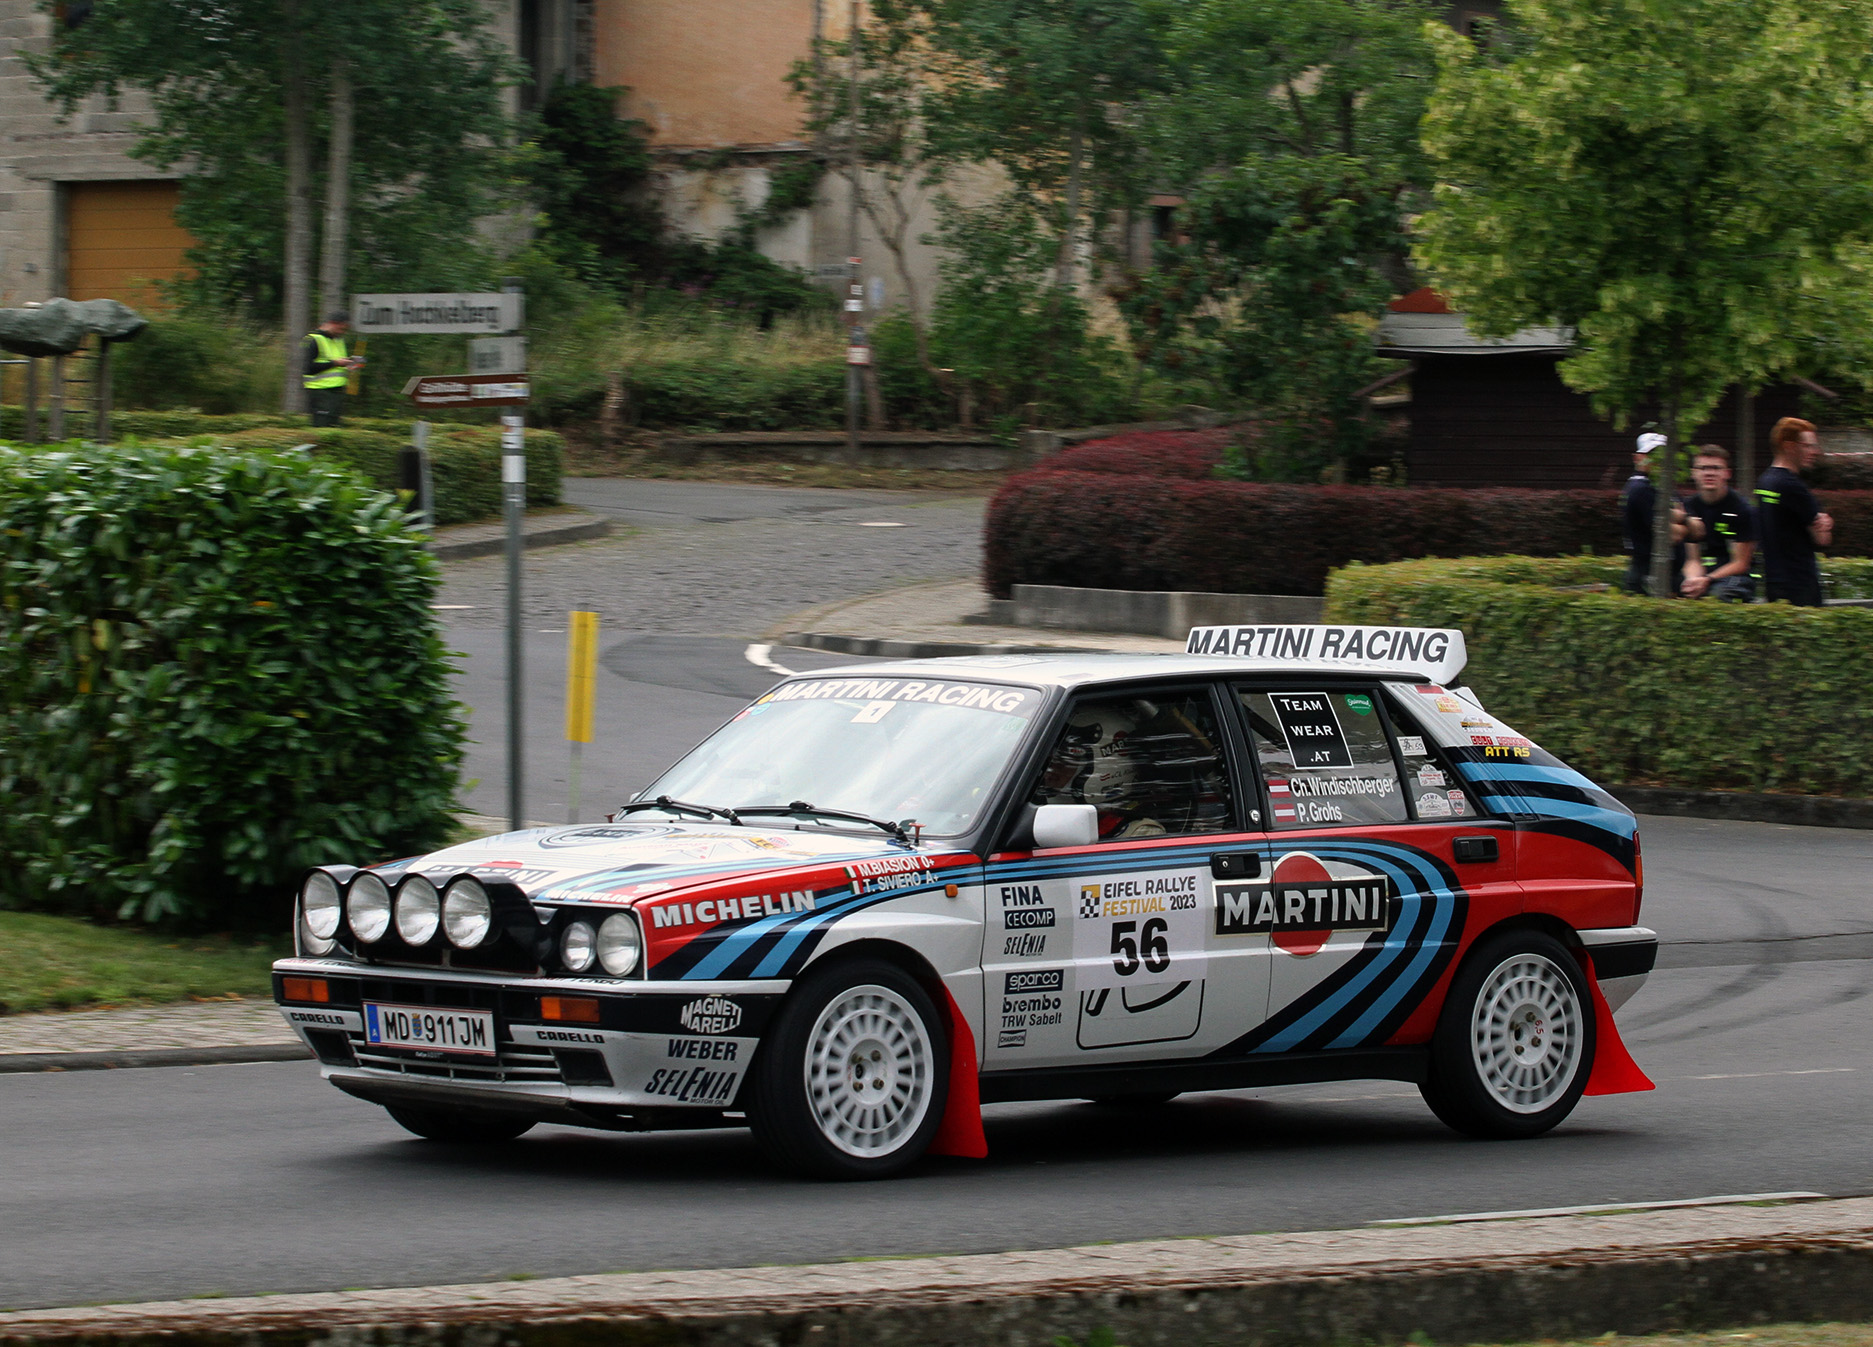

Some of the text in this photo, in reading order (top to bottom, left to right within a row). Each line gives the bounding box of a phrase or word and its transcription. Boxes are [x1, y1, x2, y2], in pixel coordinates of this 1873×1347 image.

[1187, 628, 1449, 663] MARTINI RACING
[773, 680, 1025, 712] MARTINI RACING
[1280, 699, 1323, 711] TEAM
[1290, 725, 1334, 736] WEAR
[1290, 776, 1395, 798] Ch.Windischberger
[877, 871, 922, 892] SIVIERO
[1104, 876, 1196, 899] EIFEL RALLYE
[544, 889, 635, 903] MICHELIN
[1001, 886, 1044, 907] FINA
[1103, 894, 1196, 917] FESTIVAL 2023
[1223, 887, 1380, 926] MARTINI
[650, 889, 816, 929] MICHELIN
[1007, 911, 1054, 927] CECOMP
[1003, 933, 1046, 956] SELENIA
[1110, 918, 1171, 977] 56
[1009, 972, 1060, 991] sparco
[681, 998, 742, 1024] MAGNETI
[1002, 994, 1062, 1013] brembo
[290, 1012, 345, 1025] CARELLO
[384, 1011, 410, 1041] MD
[681, 1007, 742, 1034] MARELLI
[1001, 1012, 1063, 1028] TRW Sabelt
[536, 1030, 606, 1044] CARELLO
[668, 1039, 738, 1060] WEBER
[644, 1067, 738, 1102] SELENIA
